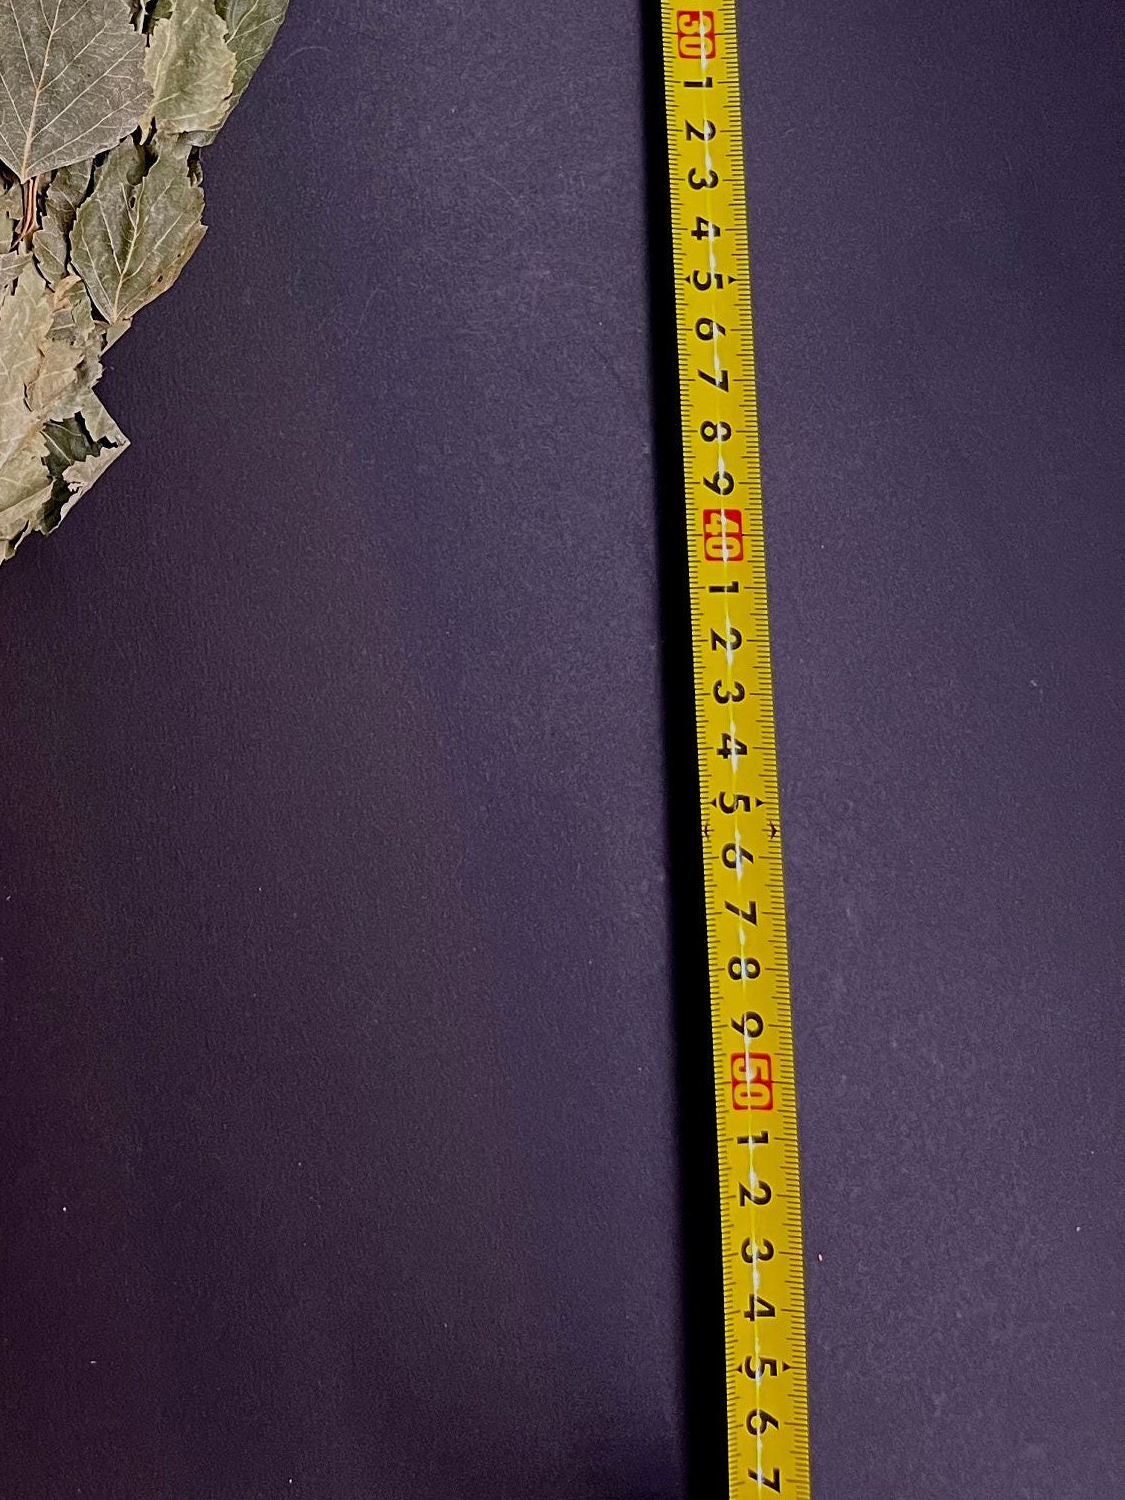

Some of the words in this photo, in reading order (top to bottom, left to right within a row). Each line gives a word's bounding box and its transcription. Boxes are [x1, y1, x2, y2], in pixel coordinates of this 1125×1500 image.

[680, 14, 712, 56] 30
[684, 77, 712, 87] 1
[685, 120, 715, 141] 2
[688, 168, 718, 189] 3
[691, 217, 721, 240] 4
[693, 270, 723, 290] 5
[695, 318, 725, 341] 6
[698, 369, 729, 392] 7
[700, 421, 731, 442] 8
[703, 471, 734, 495] 9
[706, 512, 740, 558] 40
[709, 581, 738, 592] 1
[710, 628, 742, 650] 2
[713, 680, 745, 704] 3
[717, 733, 747, 759] 4
[719, 792, 750, 814] 5
[722, 843, 754, 869] 6
[725, 901, 757, 926] 7
[727, 957, 760, 980] 8
[731, 1012, 763, 1037] 9
[733, 1056, 770, 1107] 50
[737, 1131, 768, 1143] 1
[738, 1181, 771, 1206] 2
[741, 1237, 774, 1263] 3
[744, 1294, 775, 1321] 4
[745, 1356, 777, 1379] 5
[746, 1409, 779, 1435] 6
[748, 1468, 781, 1493] 7
